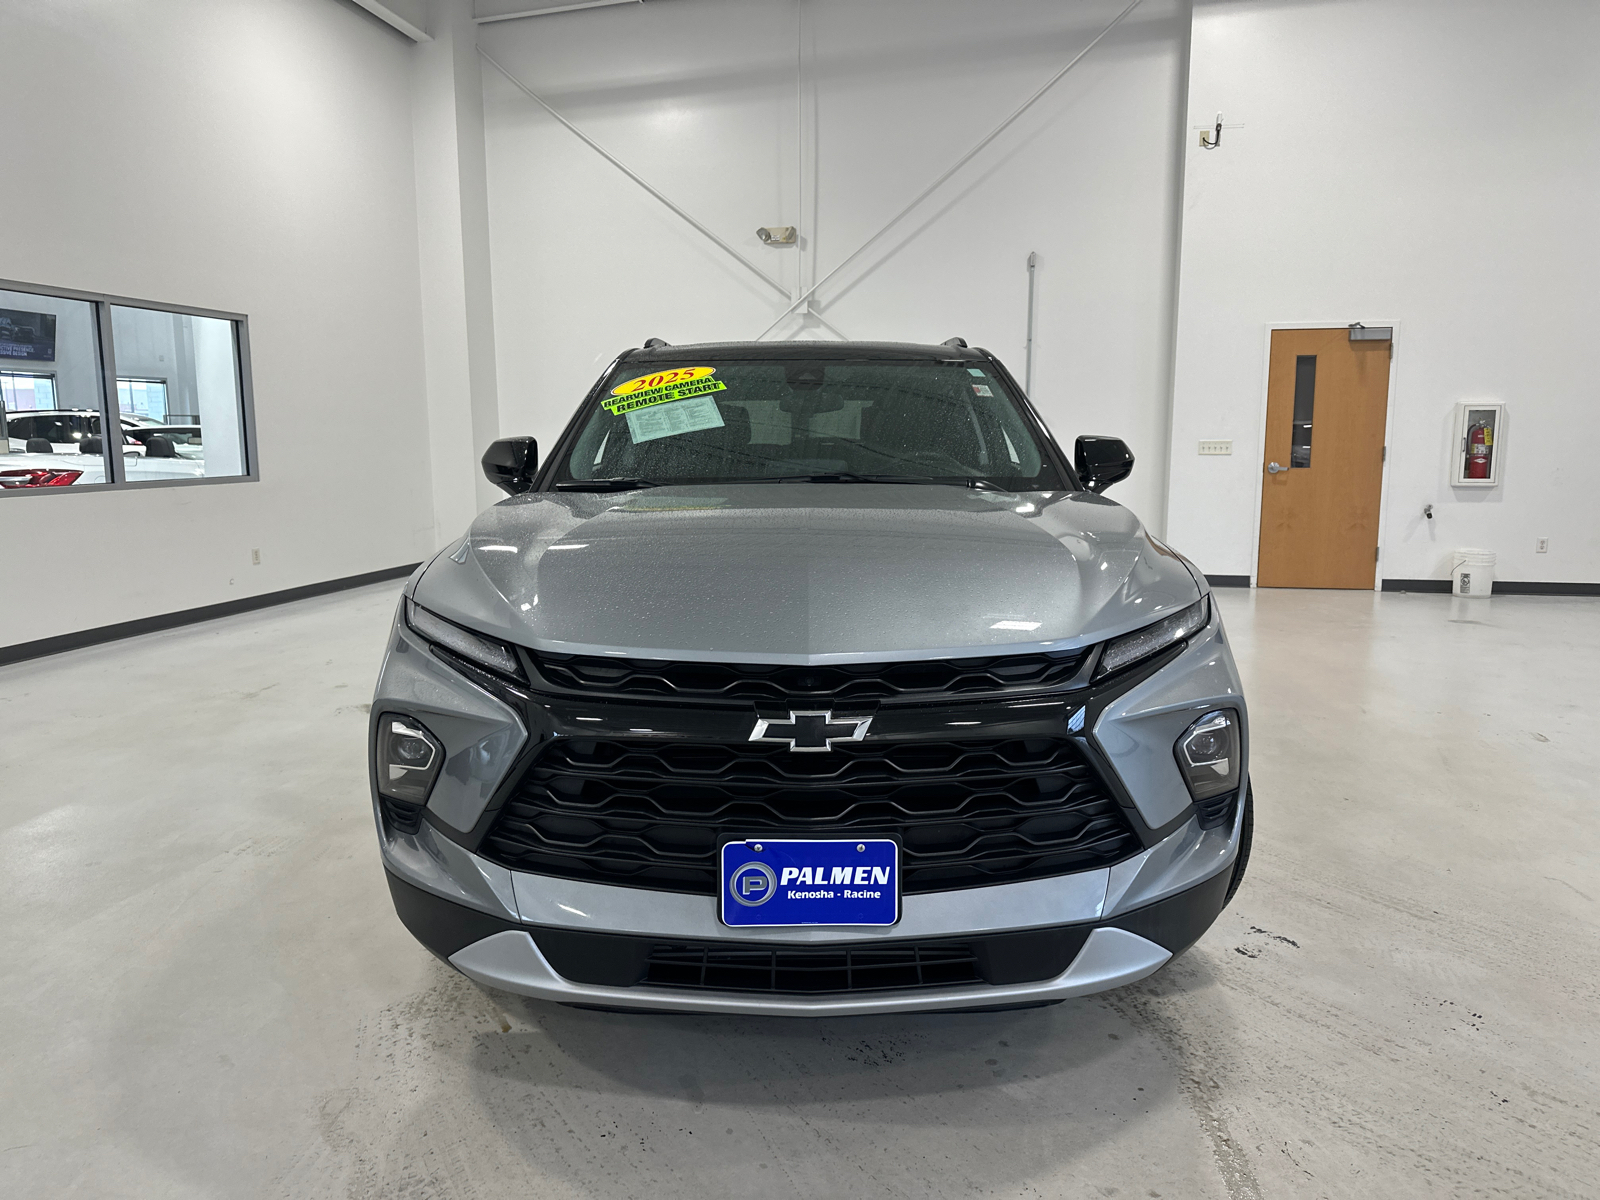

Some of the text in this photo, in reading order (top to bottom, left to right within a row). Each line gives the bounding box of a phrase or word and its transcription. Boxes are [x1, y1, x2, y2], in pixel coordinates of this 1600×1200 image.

[604, 377, 713, 408] REARVIEW CAMERA
[631, 368, 696, 393] 2025
[616, 382, 721, 413] REMOTE START
[780, 866, 891, 886] PALMEN
[787, 889, 834, 899] Kenosha
[844, 889, 881, 899] Racine
